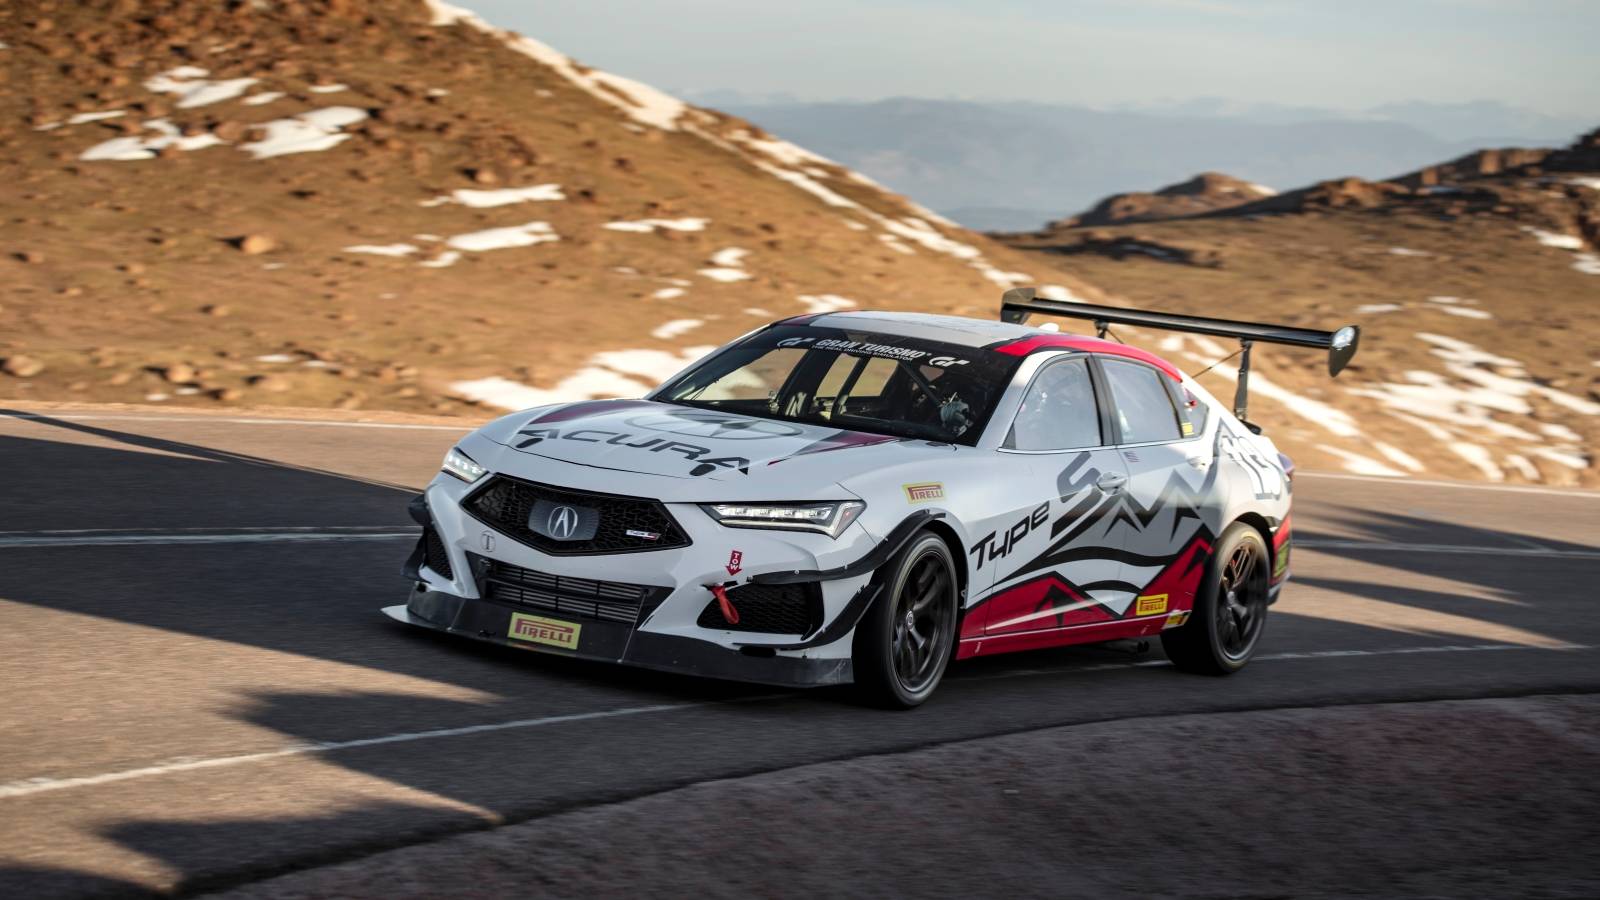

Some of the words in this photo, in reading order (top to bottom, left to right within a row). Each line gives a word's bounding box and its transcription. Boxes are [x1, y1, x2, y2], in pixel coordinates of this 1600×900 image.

[816, 339, 861, 349] GRAN
[517, 428, 750, 476] ACURA
[730, 552, 740, 571] TOW
[514, 617, 574, 643] PIRELLI
